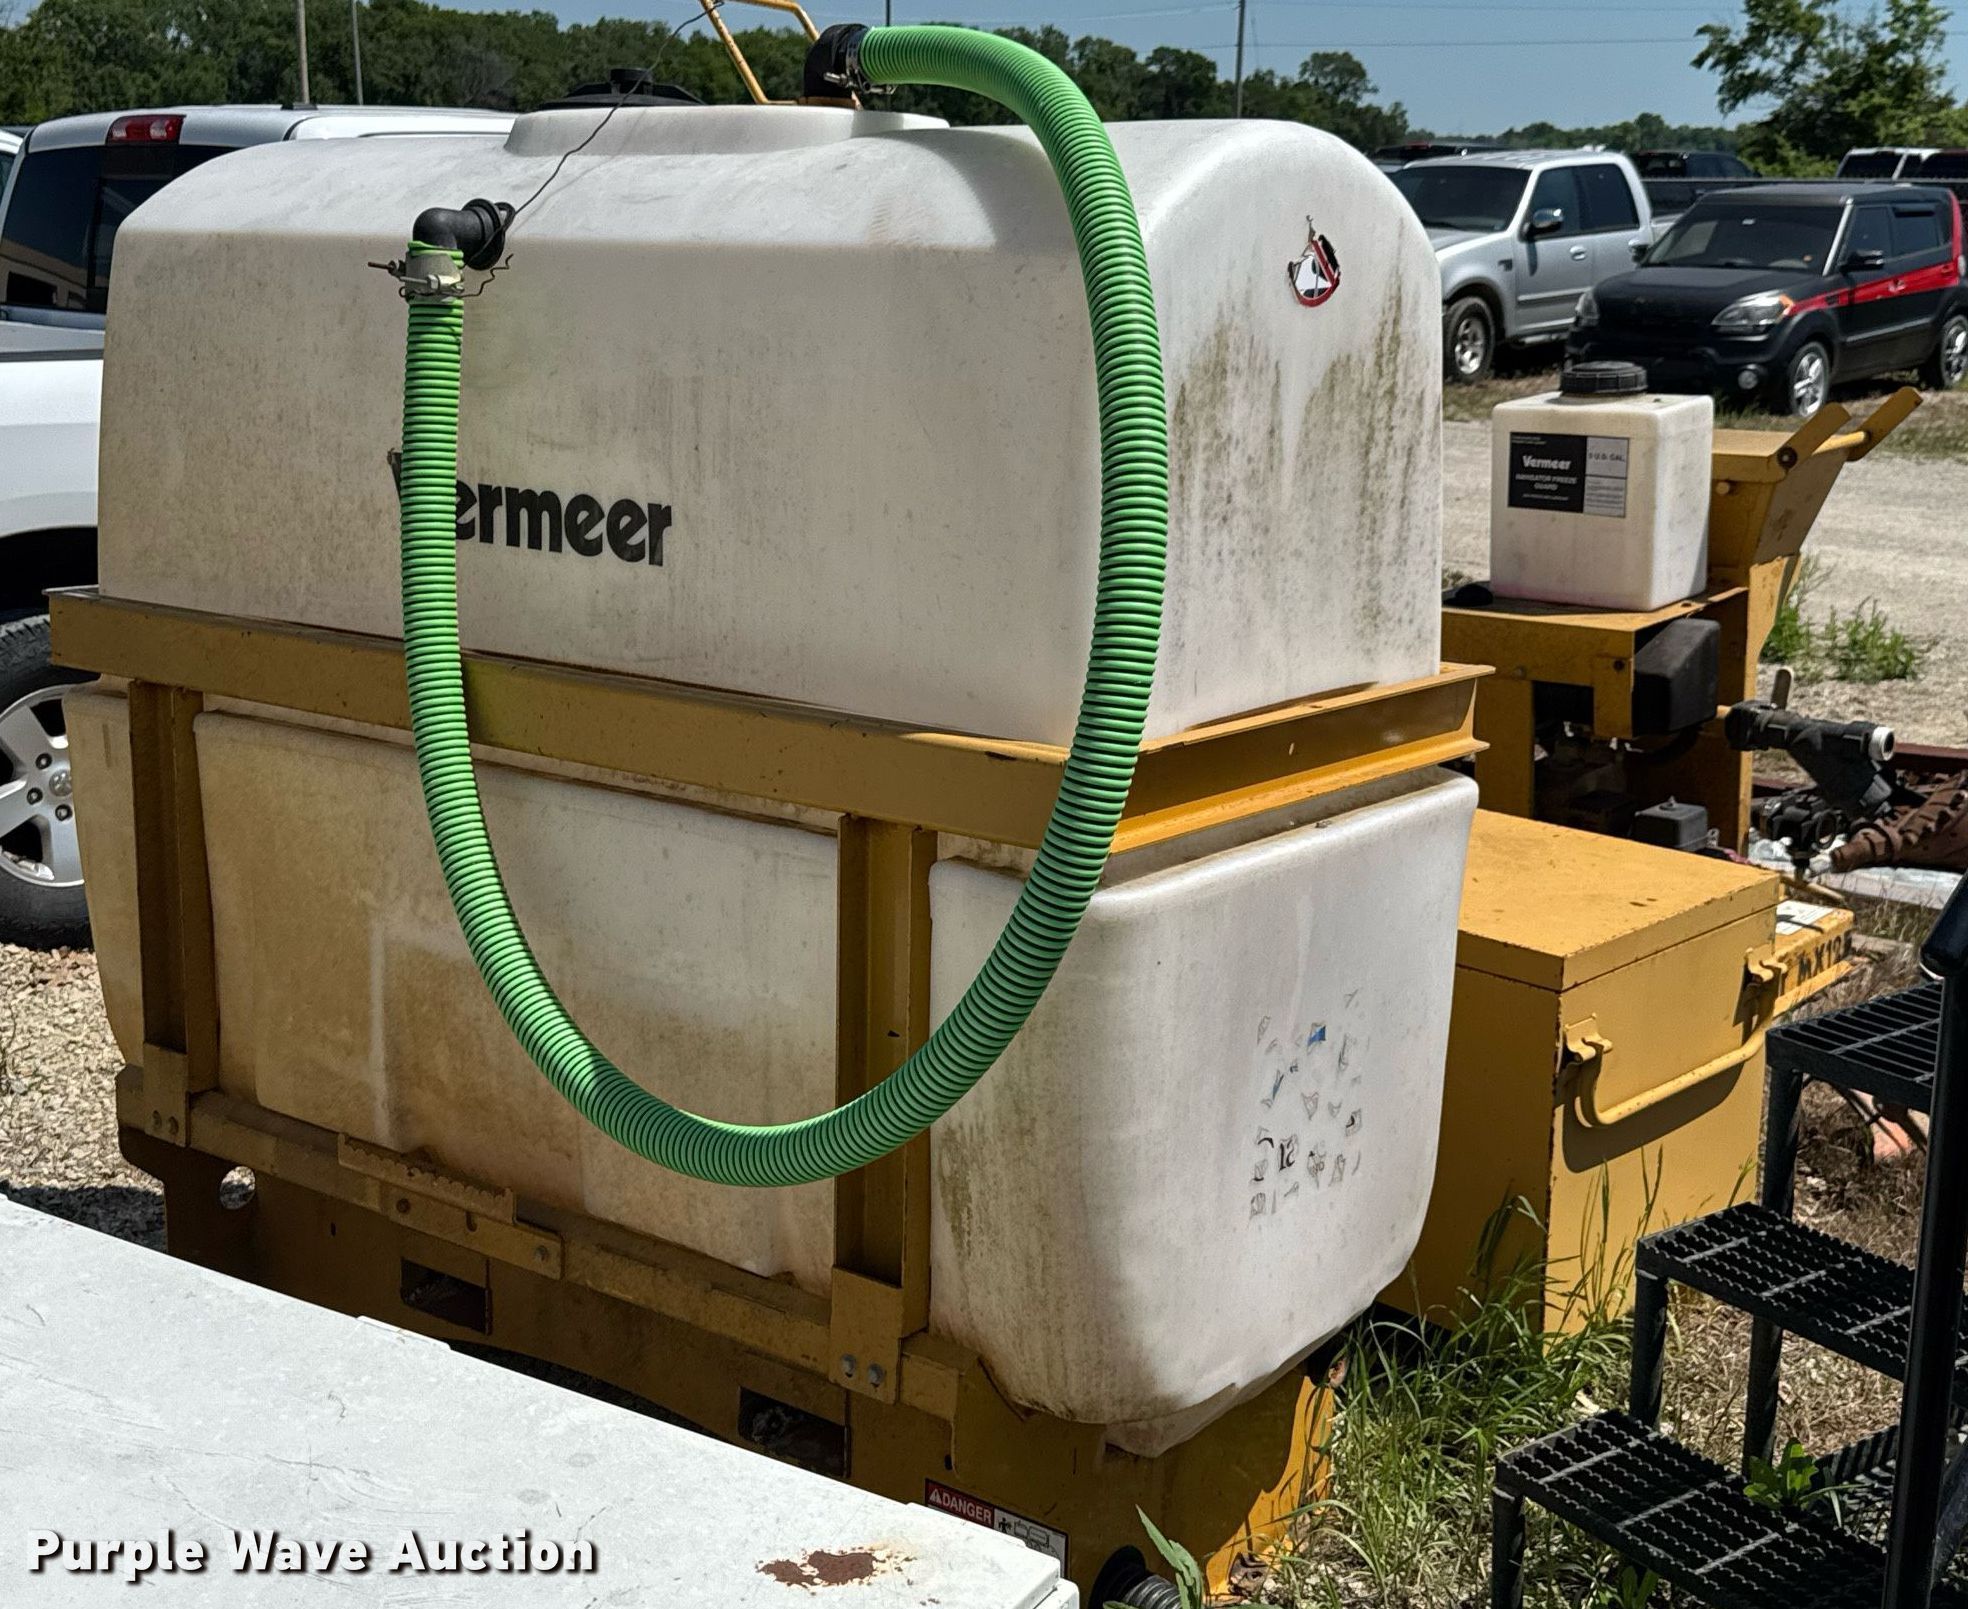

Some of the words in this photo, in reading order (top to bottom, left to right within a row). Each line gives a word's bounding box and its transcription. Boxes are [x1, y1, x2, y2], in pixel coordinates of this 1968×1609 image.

[1522, 454, 1572, 471] Vermeer
[388, 449, 672, 567] ermeer
[942, 1491, 992, 1525] DANGER
